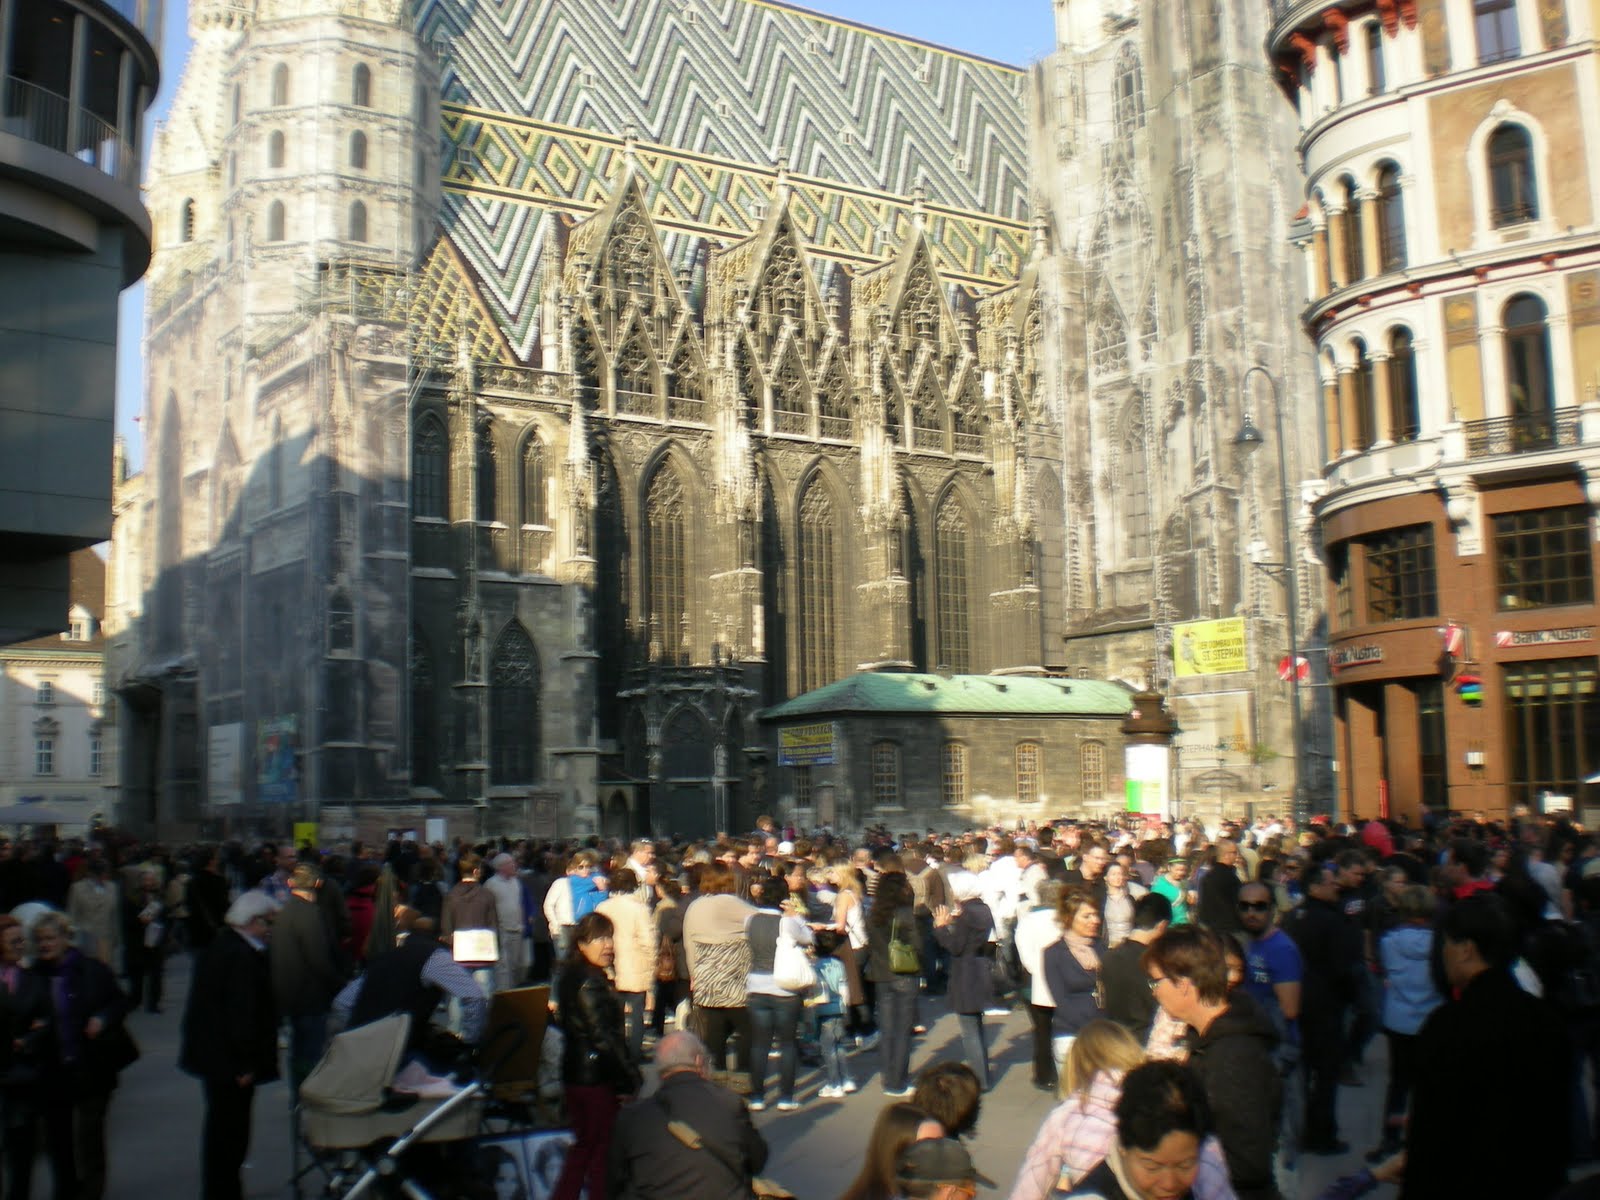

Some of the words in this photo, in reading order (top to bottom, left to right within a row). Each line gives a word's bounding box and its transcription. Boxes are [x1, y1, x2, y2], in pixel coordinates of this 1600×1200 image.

[1512, 630, 1544, 644] Bank
[1547, 627, 1592, 642] Austria
[1212, 647, 1243, 660] STEPHAN
[1350, 645, 1381, 661] Austria
